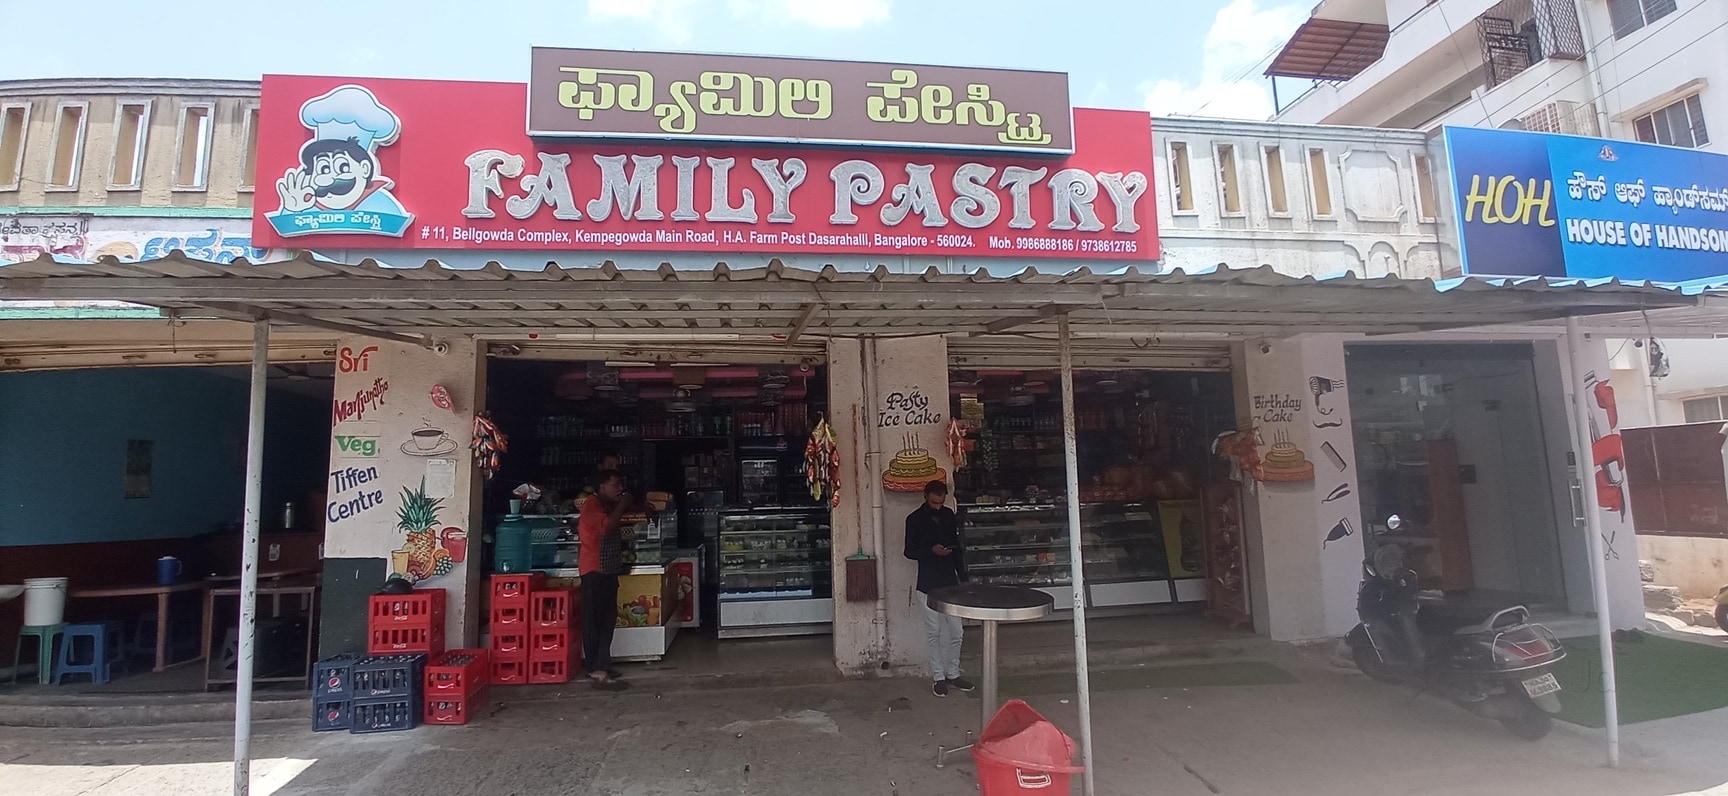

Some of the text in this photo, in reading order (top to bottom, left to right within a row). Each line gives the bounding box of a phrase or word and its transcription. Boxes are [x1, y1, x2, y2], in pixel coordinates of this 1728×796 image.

[557, 65, 1053, 145] ಫ್ಯಾಮಿಲಿ ಪೇಸ್ಟ್ರಿ
[461, 149, 1149, 235] FAMILY PASTRY
[1464, 173, 1556, 228] HOH
[1566, 171, 1607, 201] ಹೌಸ್
[1614, 178, 1646, 208] ಆಫ್
[294, 212, 345, 229] ಫ್ಯಾಮಿಲಿ
[1565, 218, 1627, 246] HOUSE
[1629, 222, 1652, 247] OF
[421, 226, 430, 239] #
[433, 227, 449, 241] 11,
[452, 227, 514, 244] Bellgowda
[517, 228, 572, 244] Complex,
[575, 229, 653, 245] Kempegowda
[655, 230, 682, 243] Main
[685, 230, 719, 246] Road,
[723, 230, 746, 244] H.A.
[750, 231, 779, 245] Farm
[781, 232, 806, 245] Post
[874, 233, 928, 248] Bangalore
[937, 234, 976, 248] 560024.
[989, 236, 1137, 252] Mob. 9986888186 / 9738612785
[338, 345, 379, 373] Sri
[1254, 394, 1302, 411] Birthday
[1263, 409, 1294, 422] Cake
[878, 411, 900, 427] Ice
[905, 408, 942, 425] Cake
[335, 435, 377, 456] Veg
[331, 466, 378, 495] Tiffen
[327, 489, 384, 523] Centre
